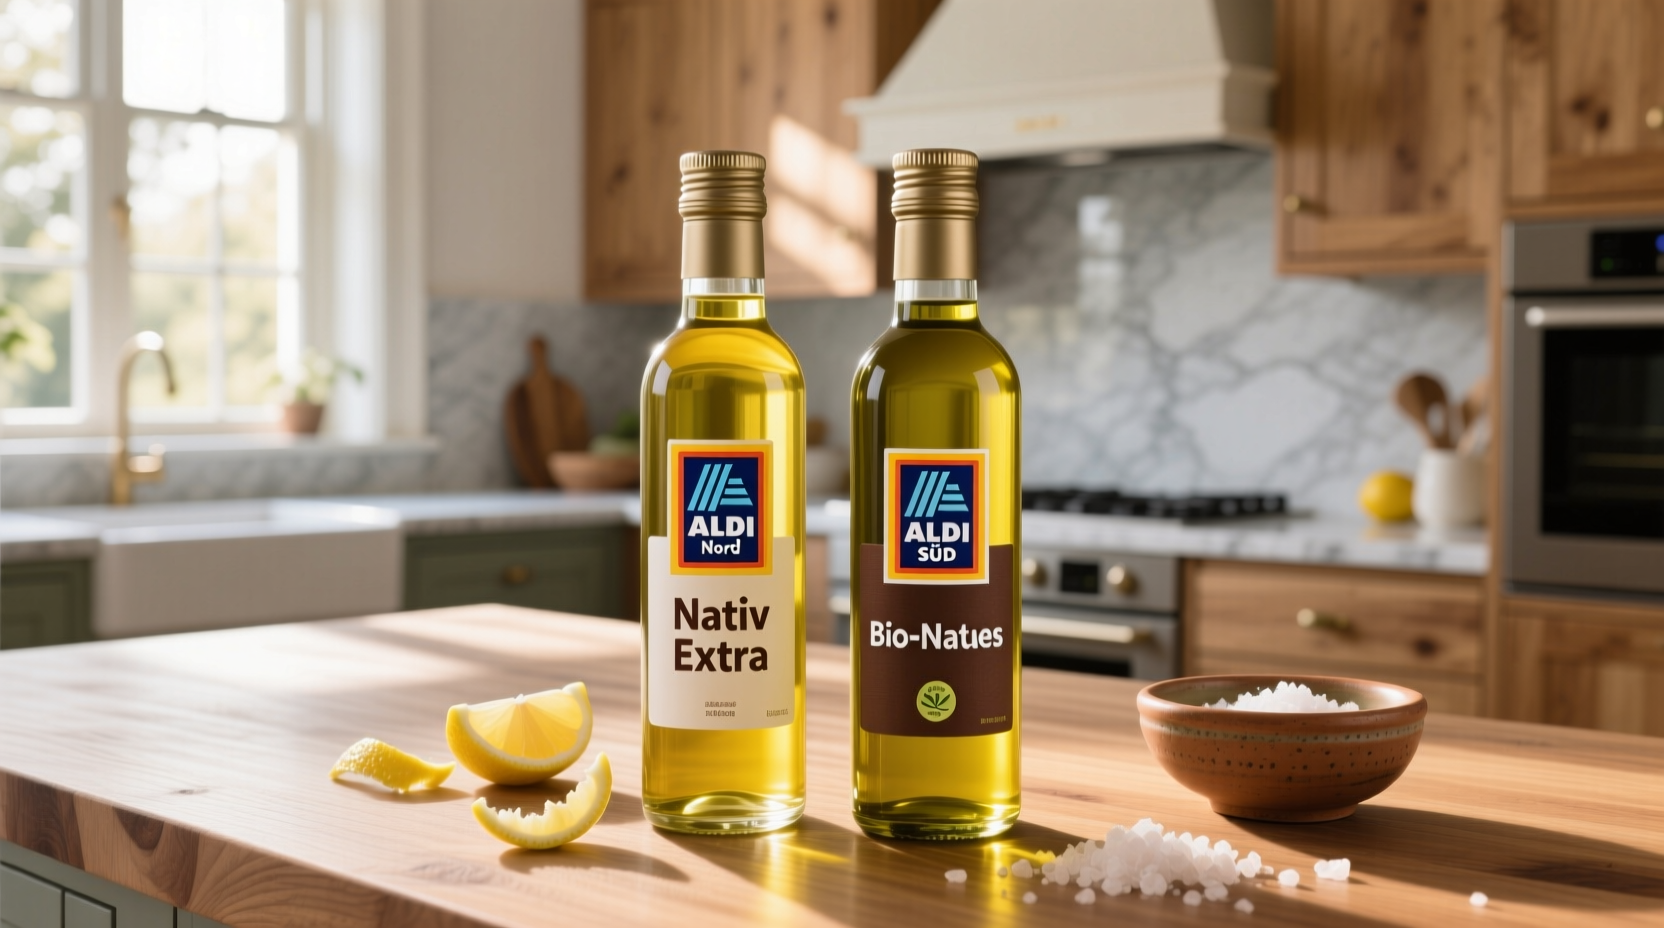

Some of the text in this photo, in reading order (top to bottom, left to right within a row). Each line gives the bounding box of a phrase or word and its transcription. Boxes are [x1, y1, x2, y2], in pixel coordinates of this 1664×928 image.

[687, 515, 755, 537] ALDI
[904, 521, 970, 543] ALDI
[701, 538, 741, 555] Nord
[917, 543, 957, 562] SÜD
[674, 596, 770, 631] Nativ
[870, 620, 1004, 650] Bio-Natues
[674, 638, 768, 673] Extra
